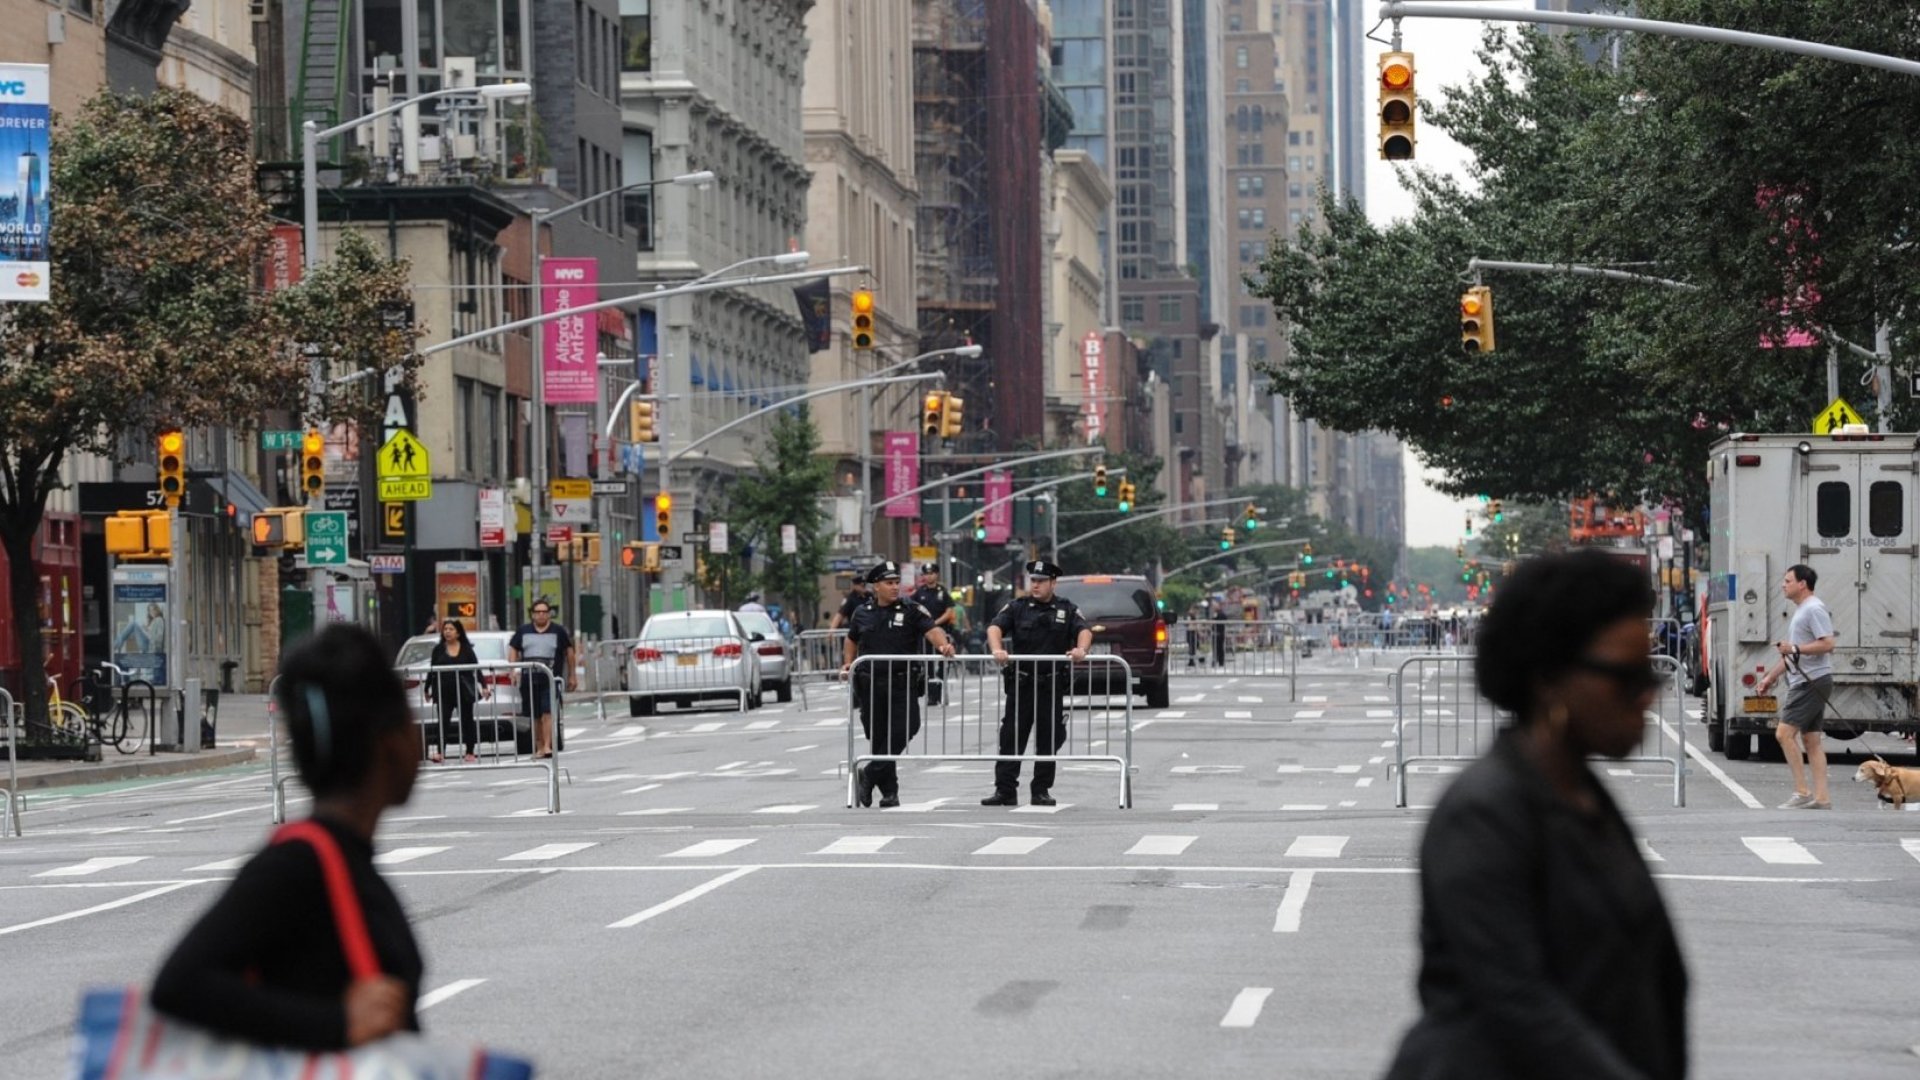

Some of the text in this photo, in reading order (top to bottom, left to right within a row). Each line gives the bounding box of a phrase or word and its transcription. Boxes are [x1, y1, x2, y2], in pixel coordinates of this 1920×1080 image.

[0, 235, 41, 245] VATORY
[555, 268, 585, 280] NYC
[555, 288, 571, 364] Affordble
[570, 314, 585, 340] Fair
[570, 341, 585, 364] Art
[264, 433, 277, 447] W
[385, 482, 426, 495] AHEAD
[374, 556, 403, 568] ATM
